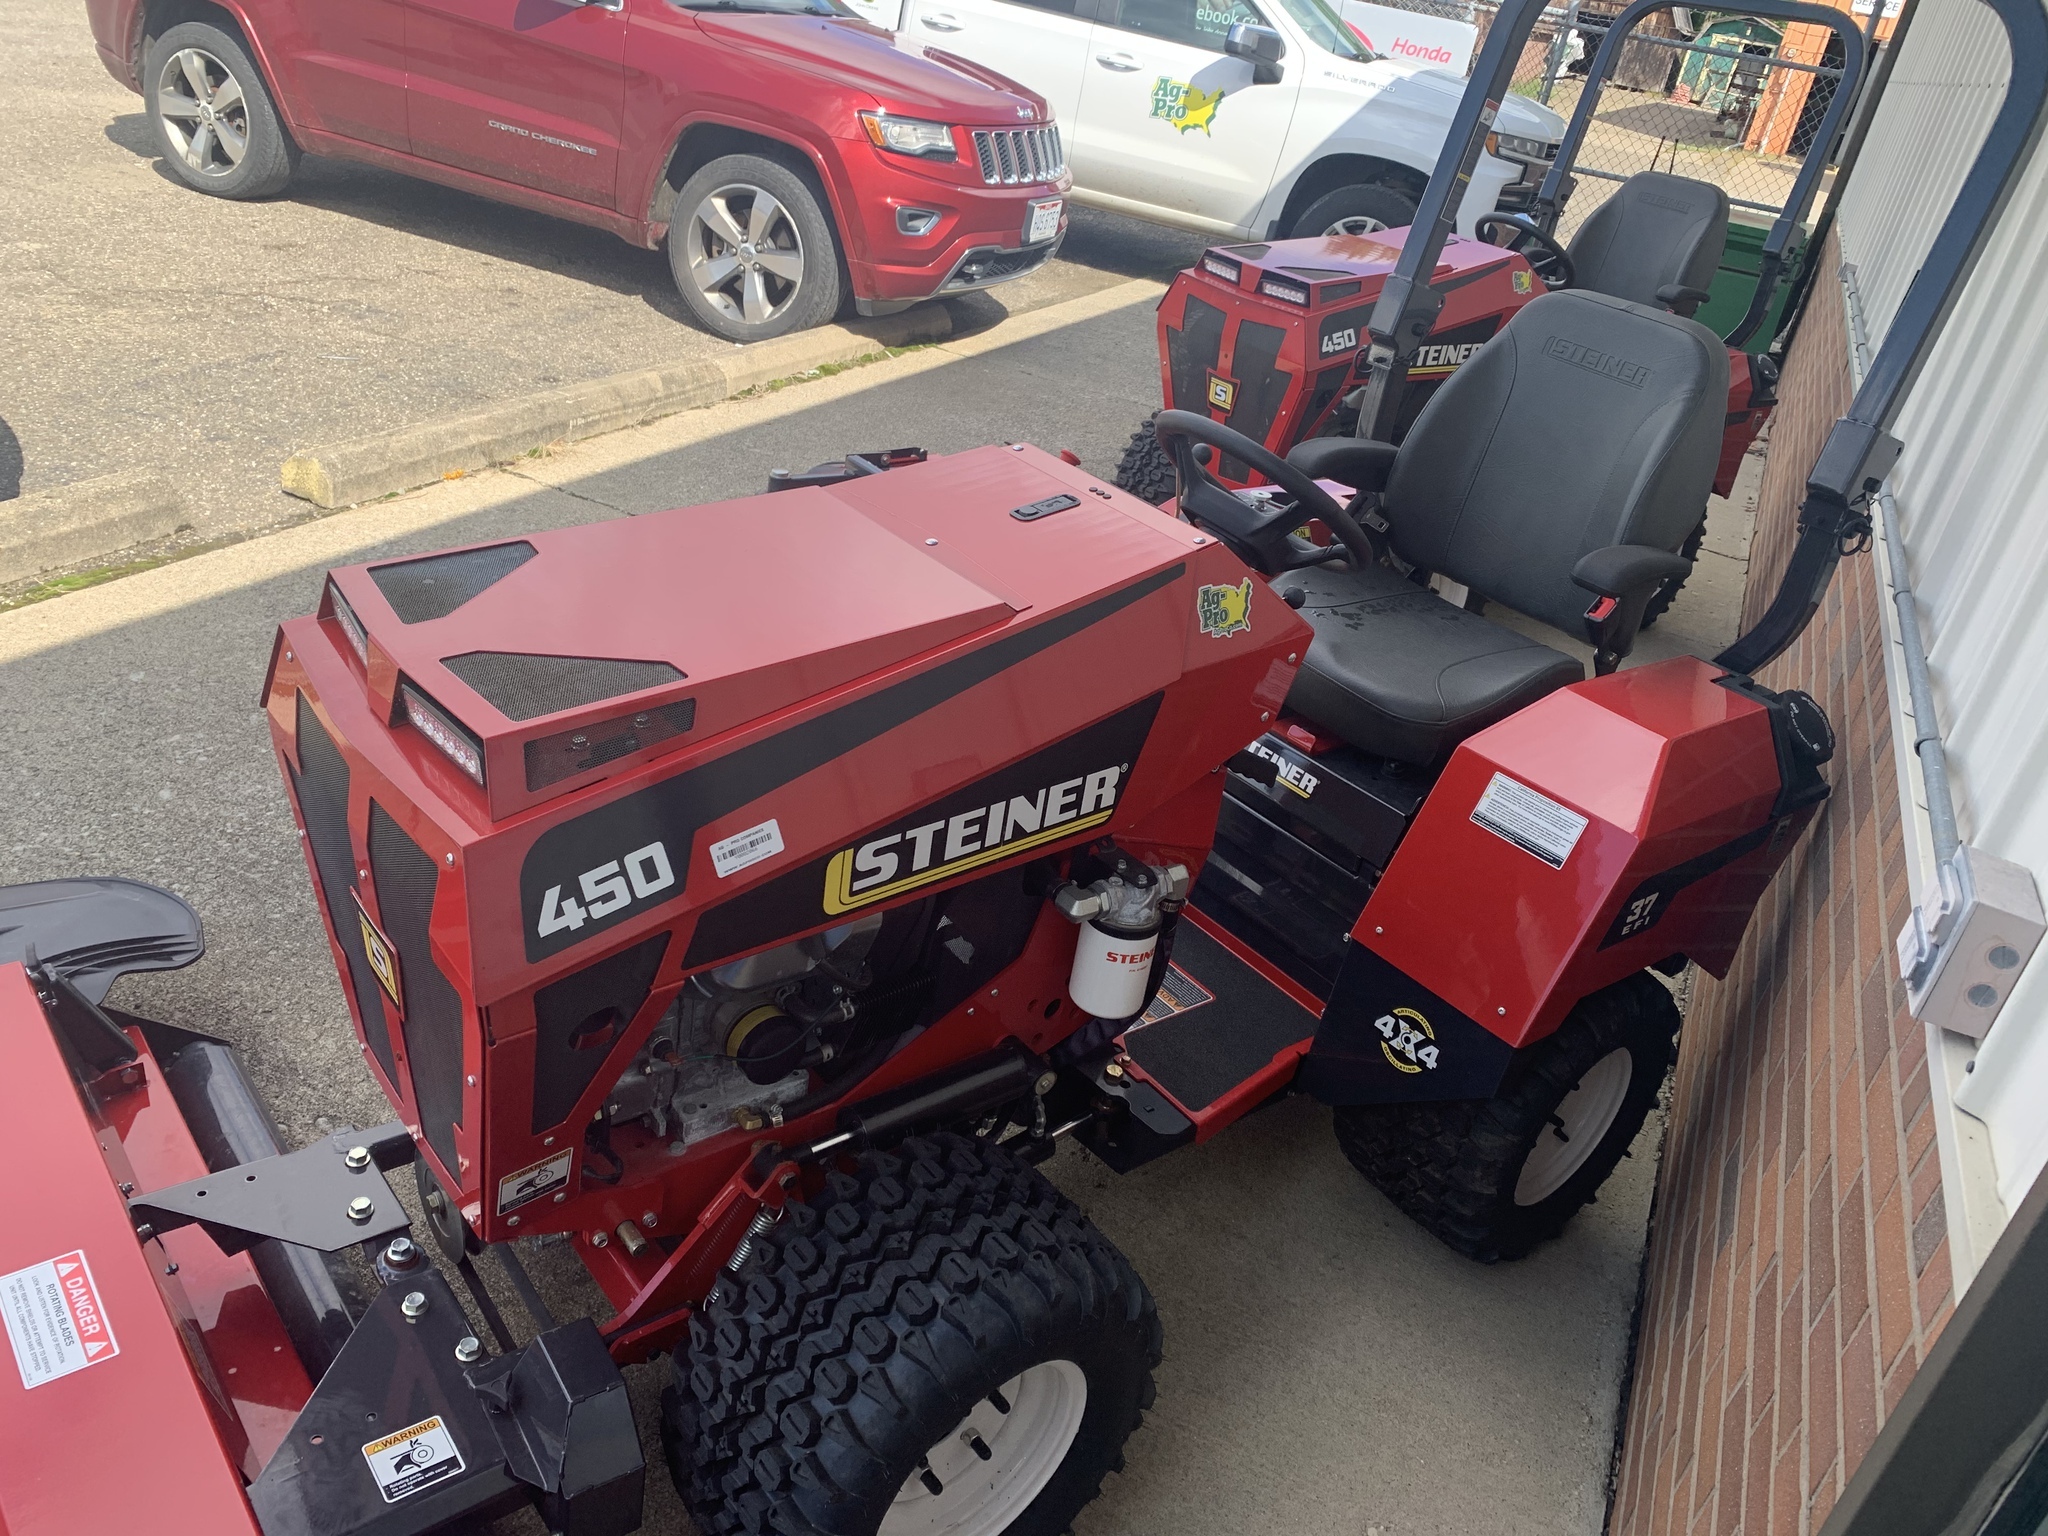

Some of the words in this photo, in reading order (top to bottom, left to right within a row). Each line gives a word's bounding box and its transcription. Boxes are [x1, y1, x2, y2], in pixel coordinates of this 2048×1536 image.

[1391, 37, 1452, 63] Honda
[1153, 78, 1190, 103] Ag-
[1324, 71, 1396, 92] SILVERADO
[1151, 98, 1188, 119] Pro
[488, 120, 529, 137] GRAND
[531, 132, 598, 156] CHEROKEE
[1321, 328, 1357, 353] 450
[1416, 343, 1484, 366] TEINE
[1552, 338, 1653, 386] STEINER
[1215, 385, 1227, 401] S
[1201, 588, 1227, 610] Ag-
[1202, 608, 1229, 629] Pro
[852, 765, 1121, 892] STEINER
[537, 841, 675, 939] 450
[1626, 892, 1659, 924] 37
[370, 936, 388, 978] S
[1397, 1009, 1433, 1037] ARTICULATING
[1383, 1045, 1417, 1072] OSCILLATING
[517, 1152, 568, 1177] WARNING
[30, 1275, 39, 1286] LOOK
[34, 1286, 42, 1296] AND
[41, 1308, 50, 1318] FOR
[46, 1283, 64, 1318] ROTATING
[58, 1317, 75, 1347] BLADES
[65, 1276, 100, 1337] DANGER
[381, 1421, 436, 1448] WARNING
